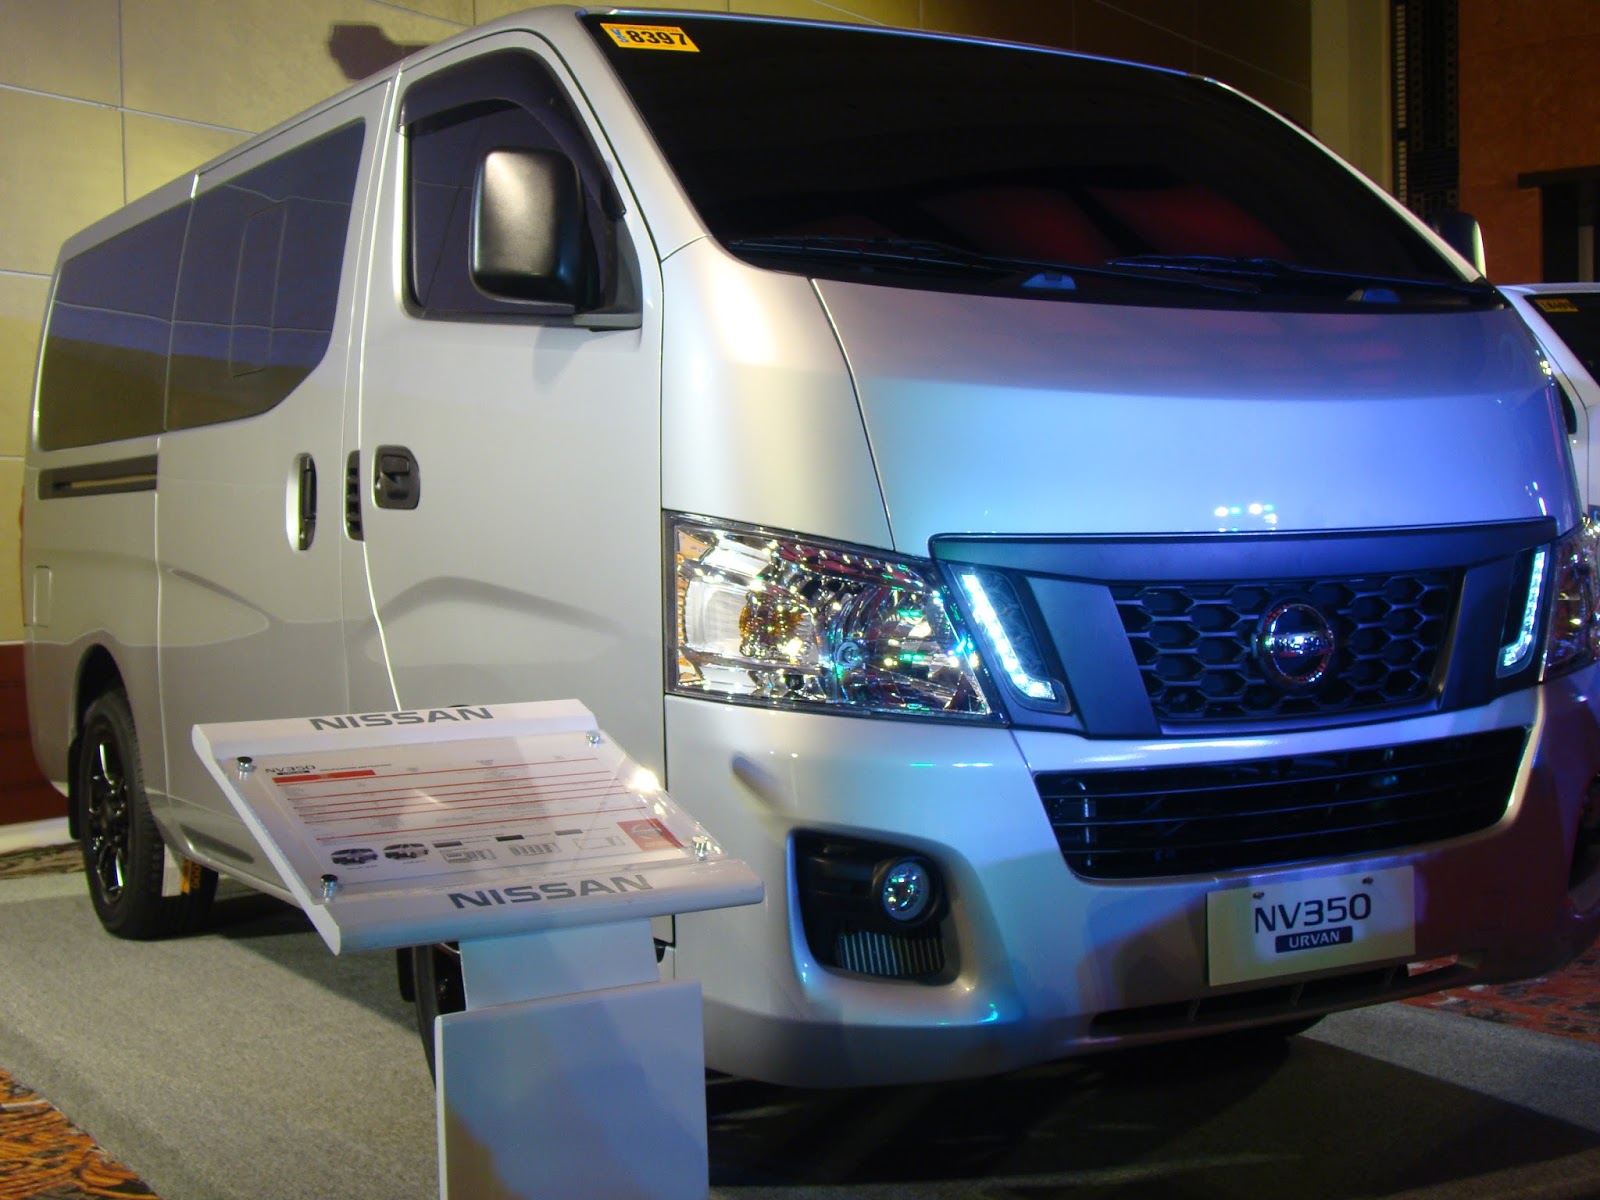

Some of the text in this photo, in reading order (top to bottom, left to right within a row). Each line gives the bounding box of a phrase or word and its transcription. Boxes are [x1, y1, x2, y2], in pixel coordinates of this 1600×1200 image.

[625, 30, 687, 46] 8397
[309, 707, 494, 731] NISSAN
[447, 874, 654, 909] NISSAN
[1254, 893, 1371, 934] NV350
[1289, 931, 1341, 949] URVAN
